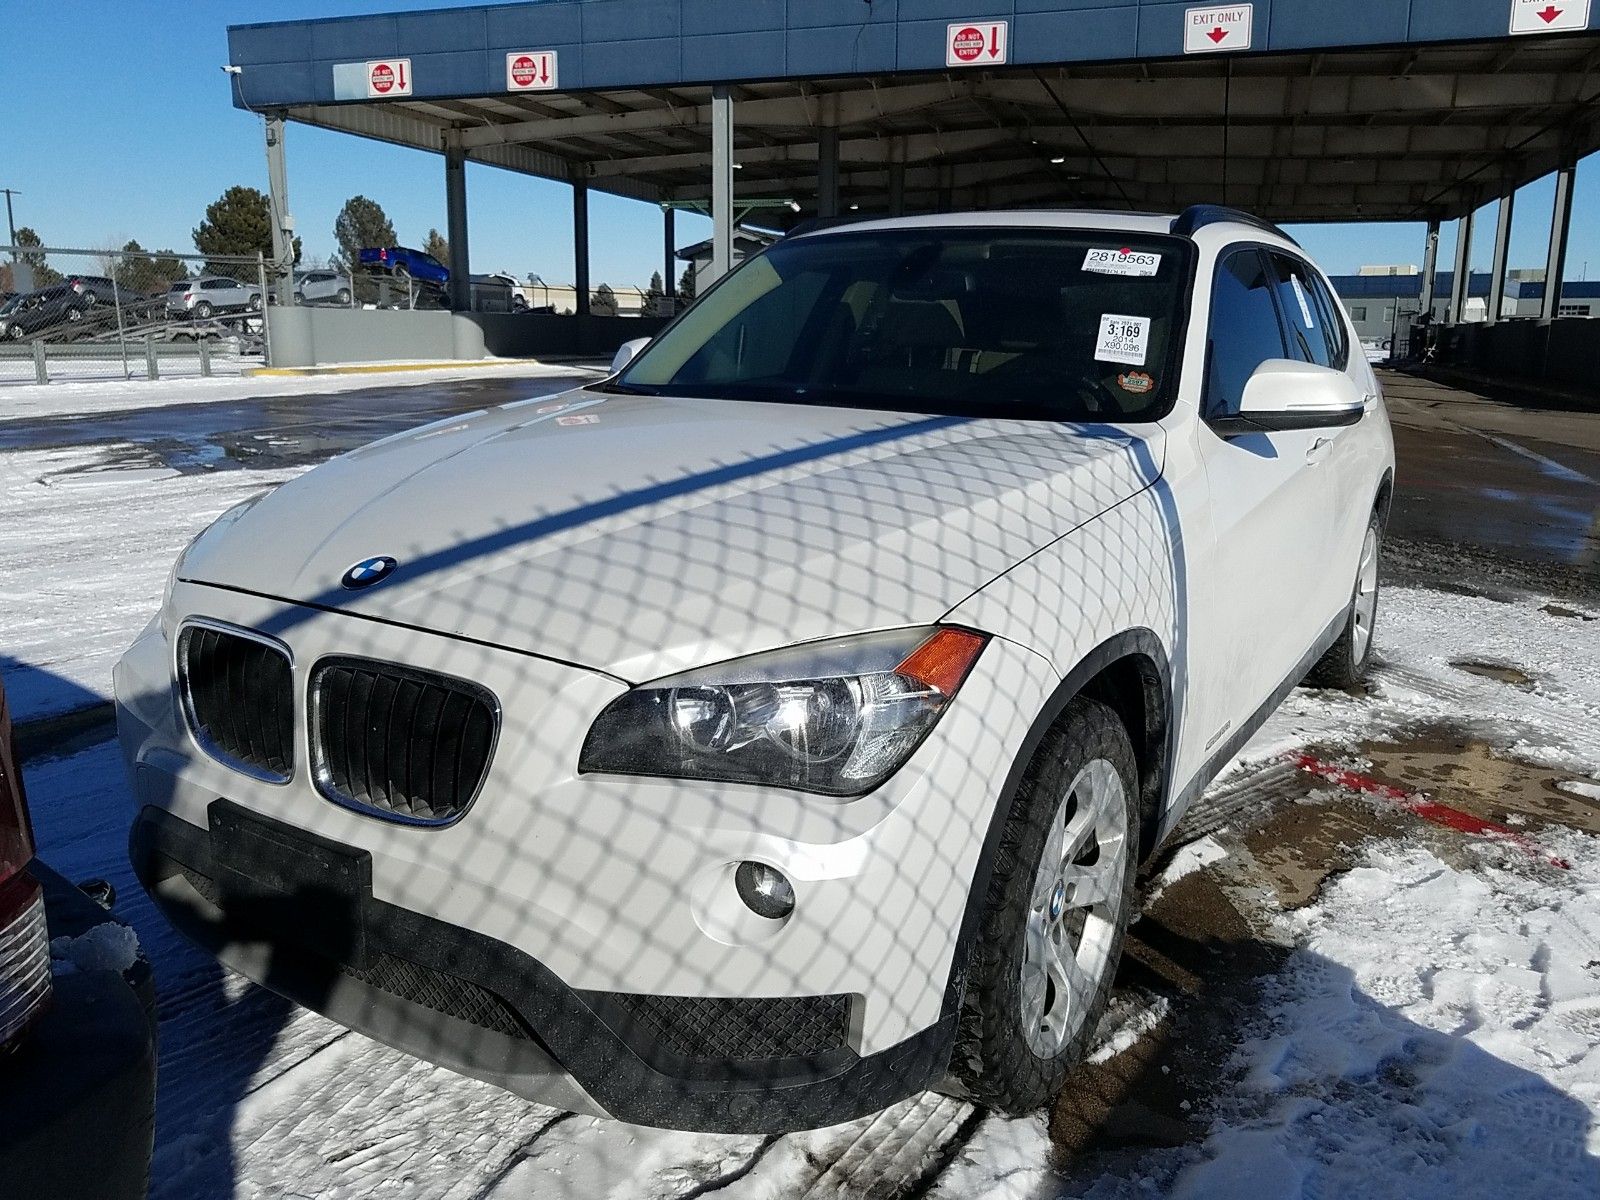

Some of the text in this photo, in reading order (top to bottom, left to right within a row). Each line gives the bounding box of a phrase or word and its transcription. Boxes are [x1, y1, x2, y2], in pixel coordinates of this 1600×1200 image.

[1193, 11, 1243, 25] EXIT ONLY
[1089, 252, 1155, 265] 2819563
[1107, 323, 1140, 338] 3:169
[1112, 335, 1134, 344] 2014
